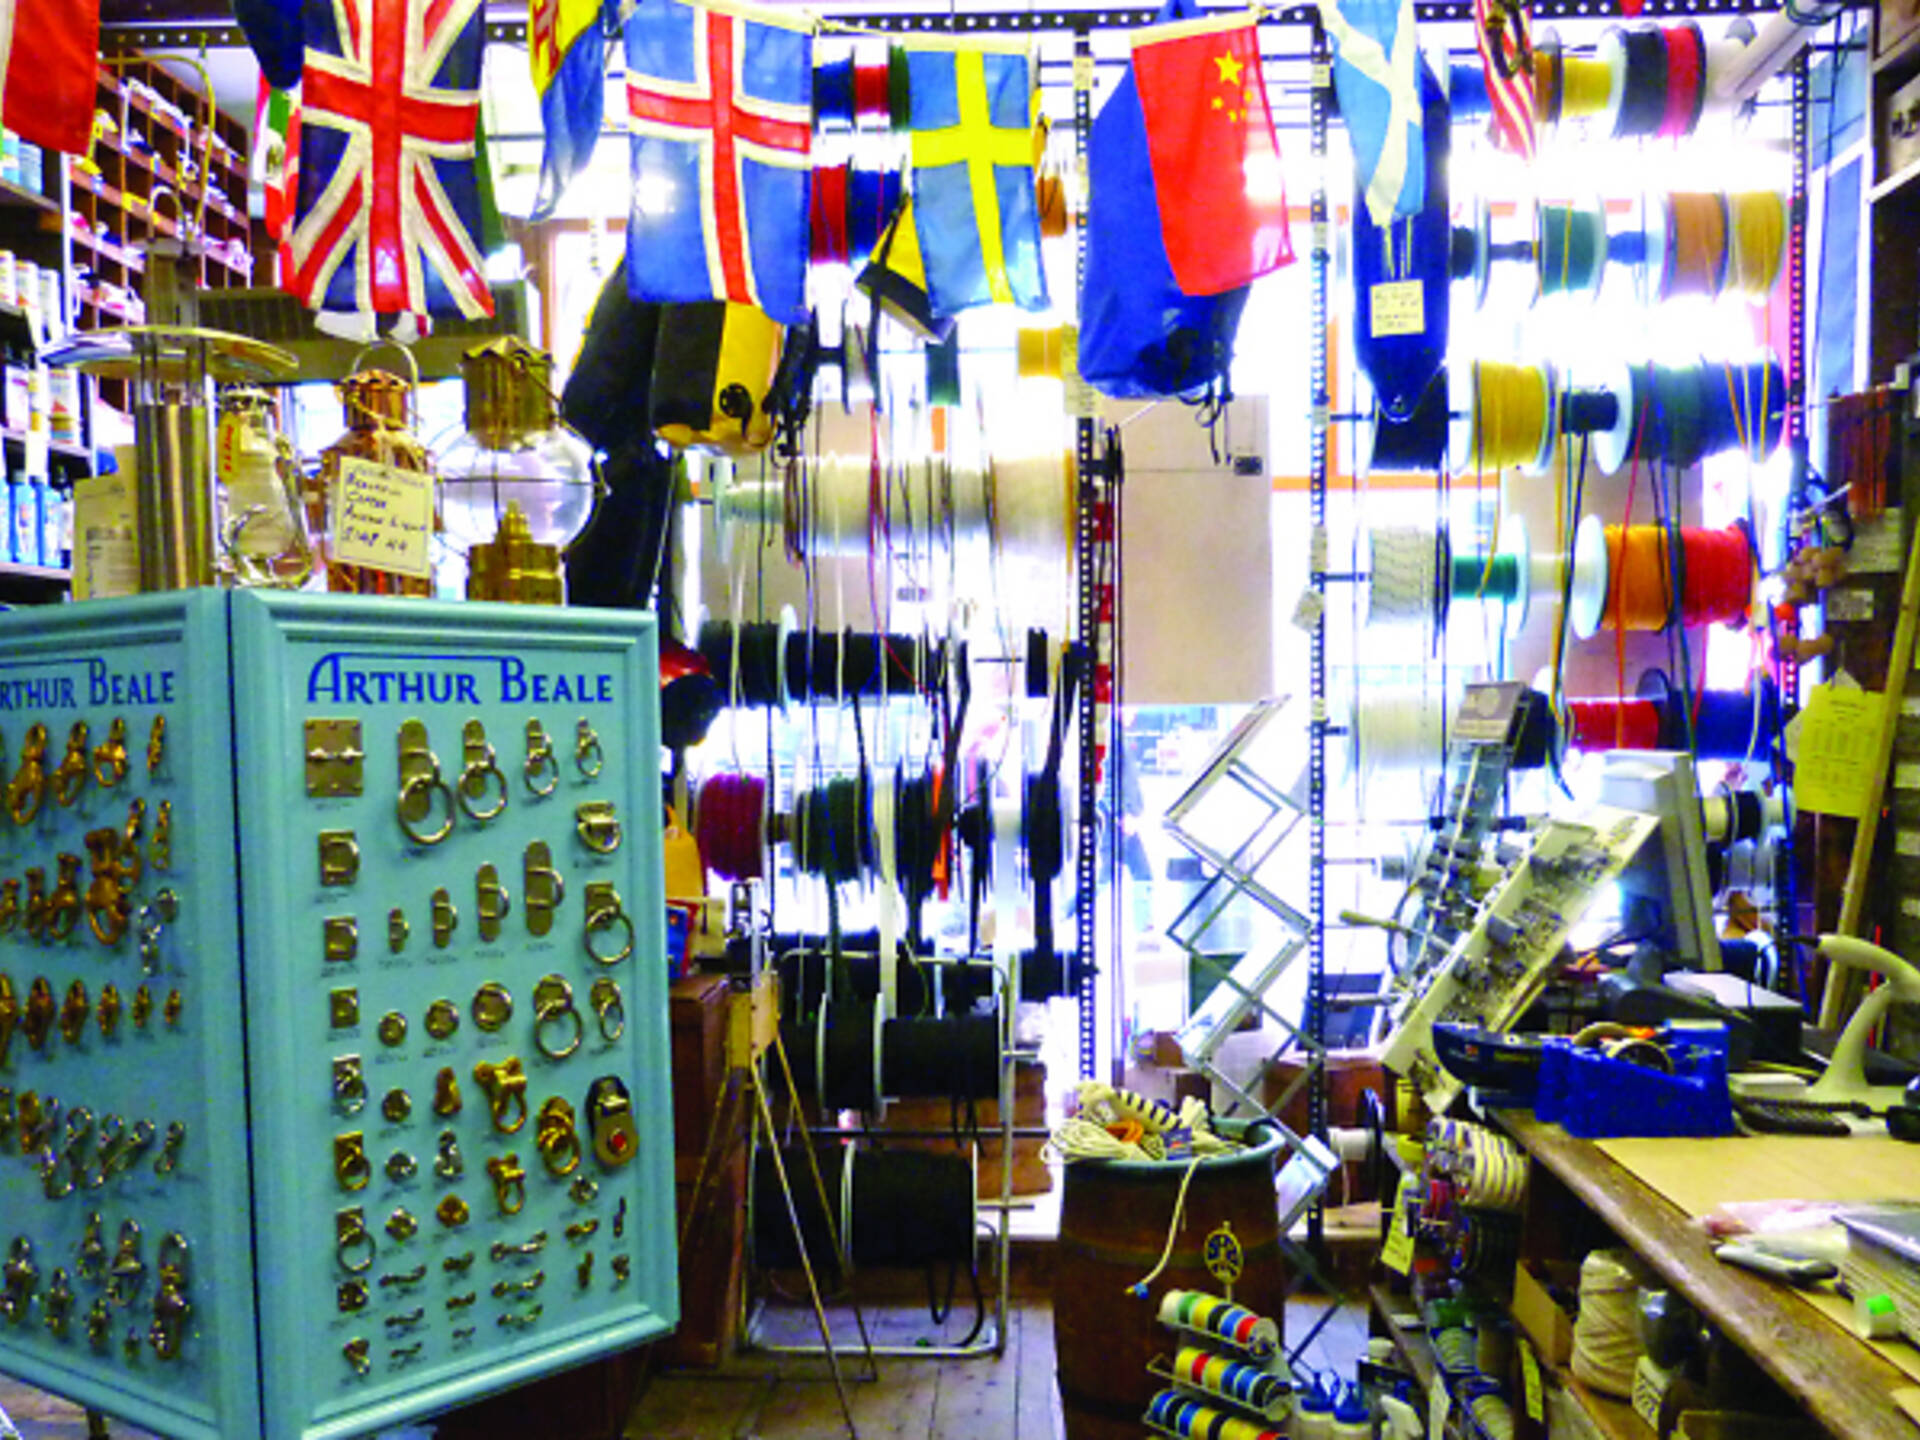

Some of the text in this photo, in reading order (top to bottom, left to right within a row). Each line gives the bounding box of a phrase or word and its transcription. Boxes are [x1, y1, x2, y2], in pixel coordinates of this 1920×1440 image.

[0, 657, 175, 710] RTHUR BEALE
[307, 652, 613, 705] ARTHUR BEALE
